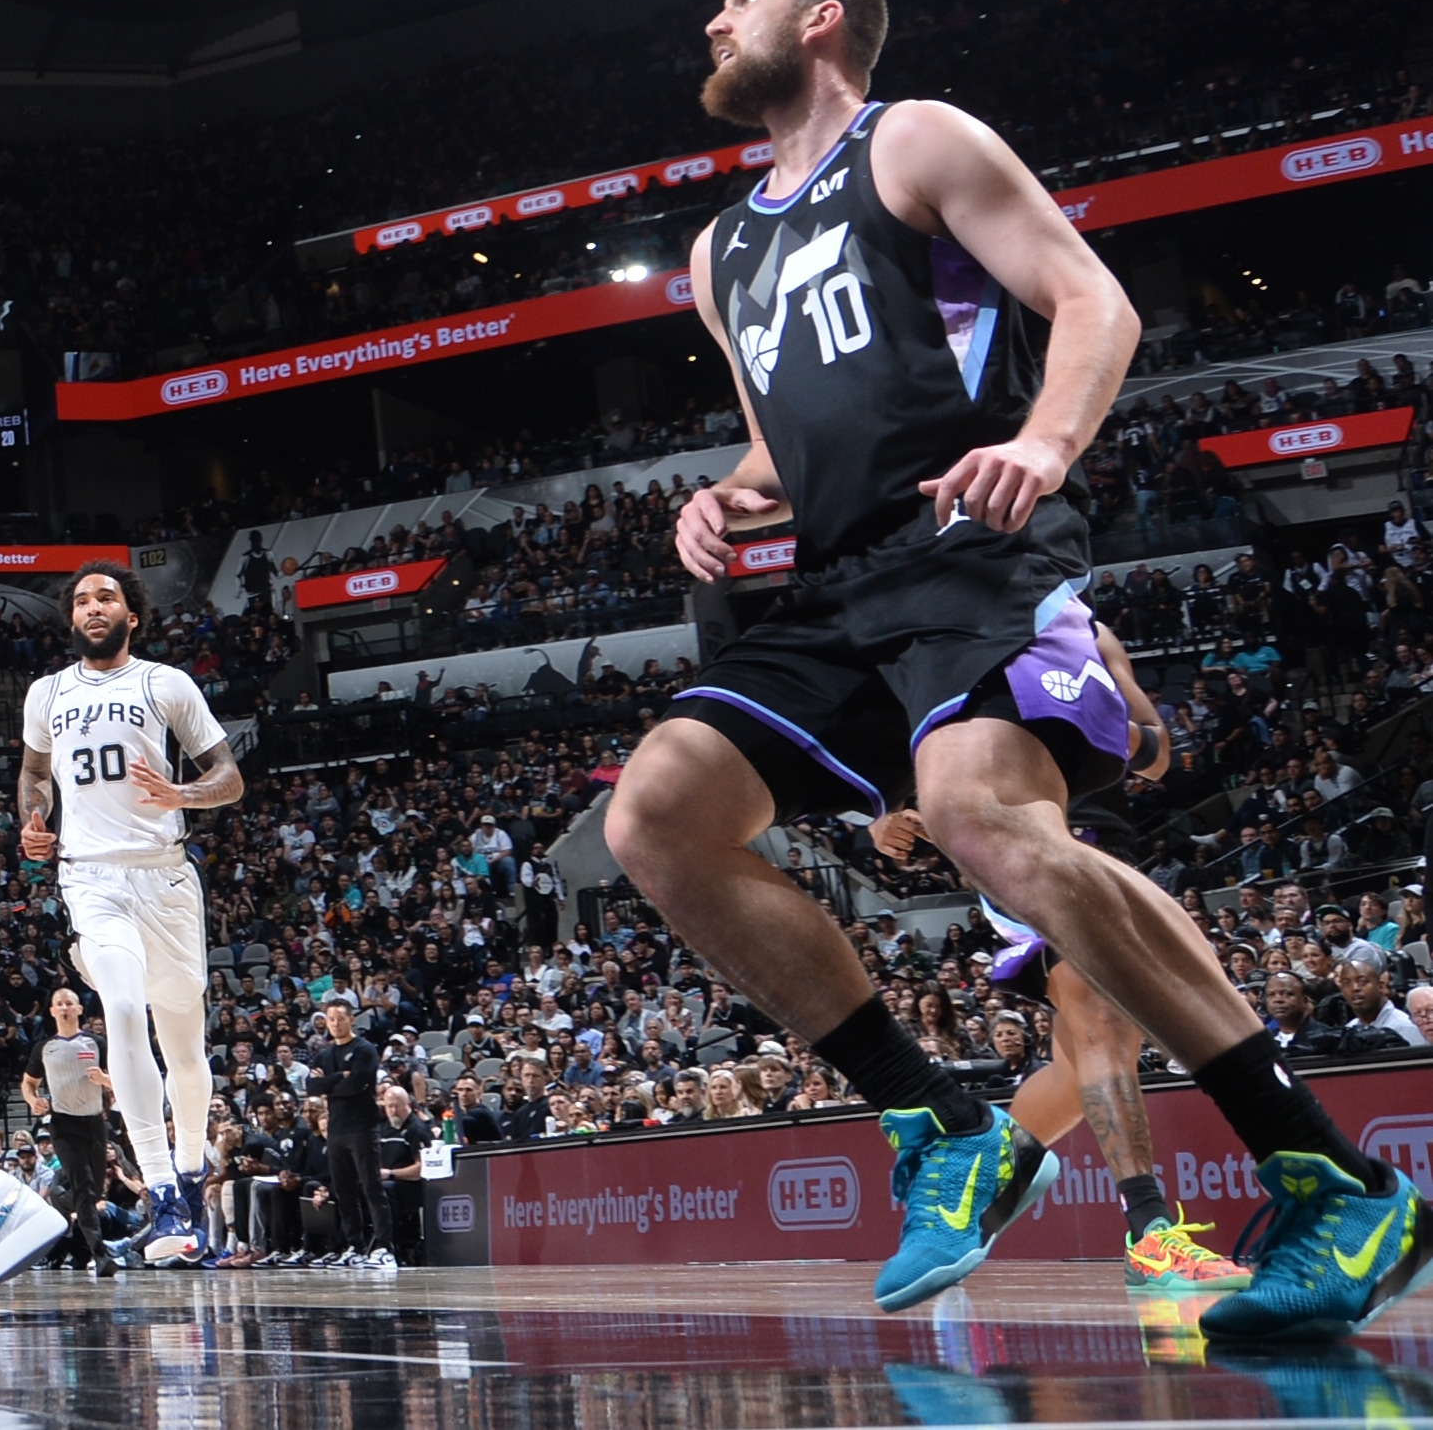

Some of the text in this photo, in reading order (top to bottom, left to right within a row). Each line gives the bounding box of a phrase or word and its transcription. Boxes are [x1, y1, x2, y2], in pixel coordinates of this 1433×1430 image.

[803, 271, 874, 366] 10
[240, 361, 291, 386] Here
[296, 332, 431, 373] Everything's
[437, 318, 509, 347] Better
[1, 431, 15, 446] 20
[141, 552, 166, 566] 102
[52, 702, 146, 740] SPURS
[72, 742, 128, 787] 30
[503, 1184, 738, 1235] Here Everything's Better
